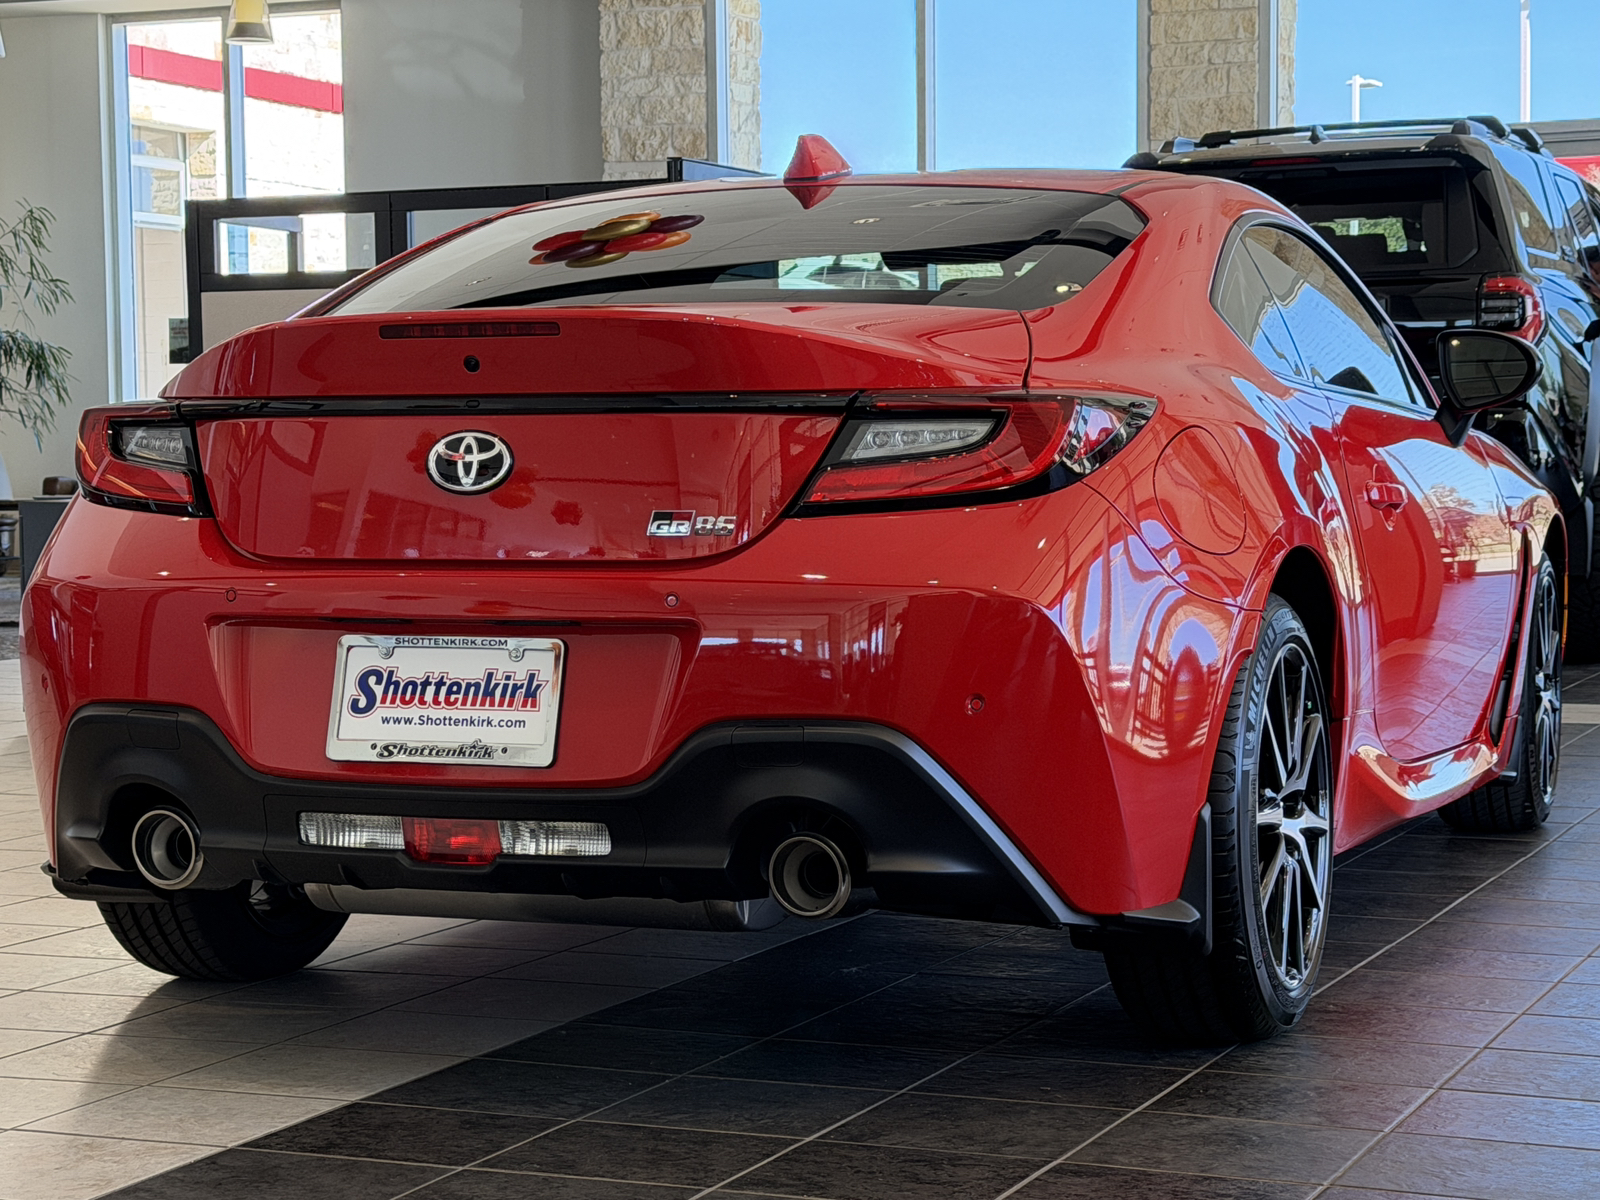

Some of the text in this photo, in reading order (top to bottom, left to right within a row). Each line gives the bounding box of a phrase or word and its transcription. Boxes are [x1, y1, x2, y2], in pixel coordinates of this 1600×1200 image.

[694, 515, 737, 536] 86
[394, 637, 508, 647] SHOTTENKIRK.COM
[1248, 626, 1278, 726] MICHELIN
[349, 667, 547, 716] Shottenkirk
[381, 715, 526, 729] www.Shottenkirk.com
[376, 742, 497, 760] Shottenkirk
